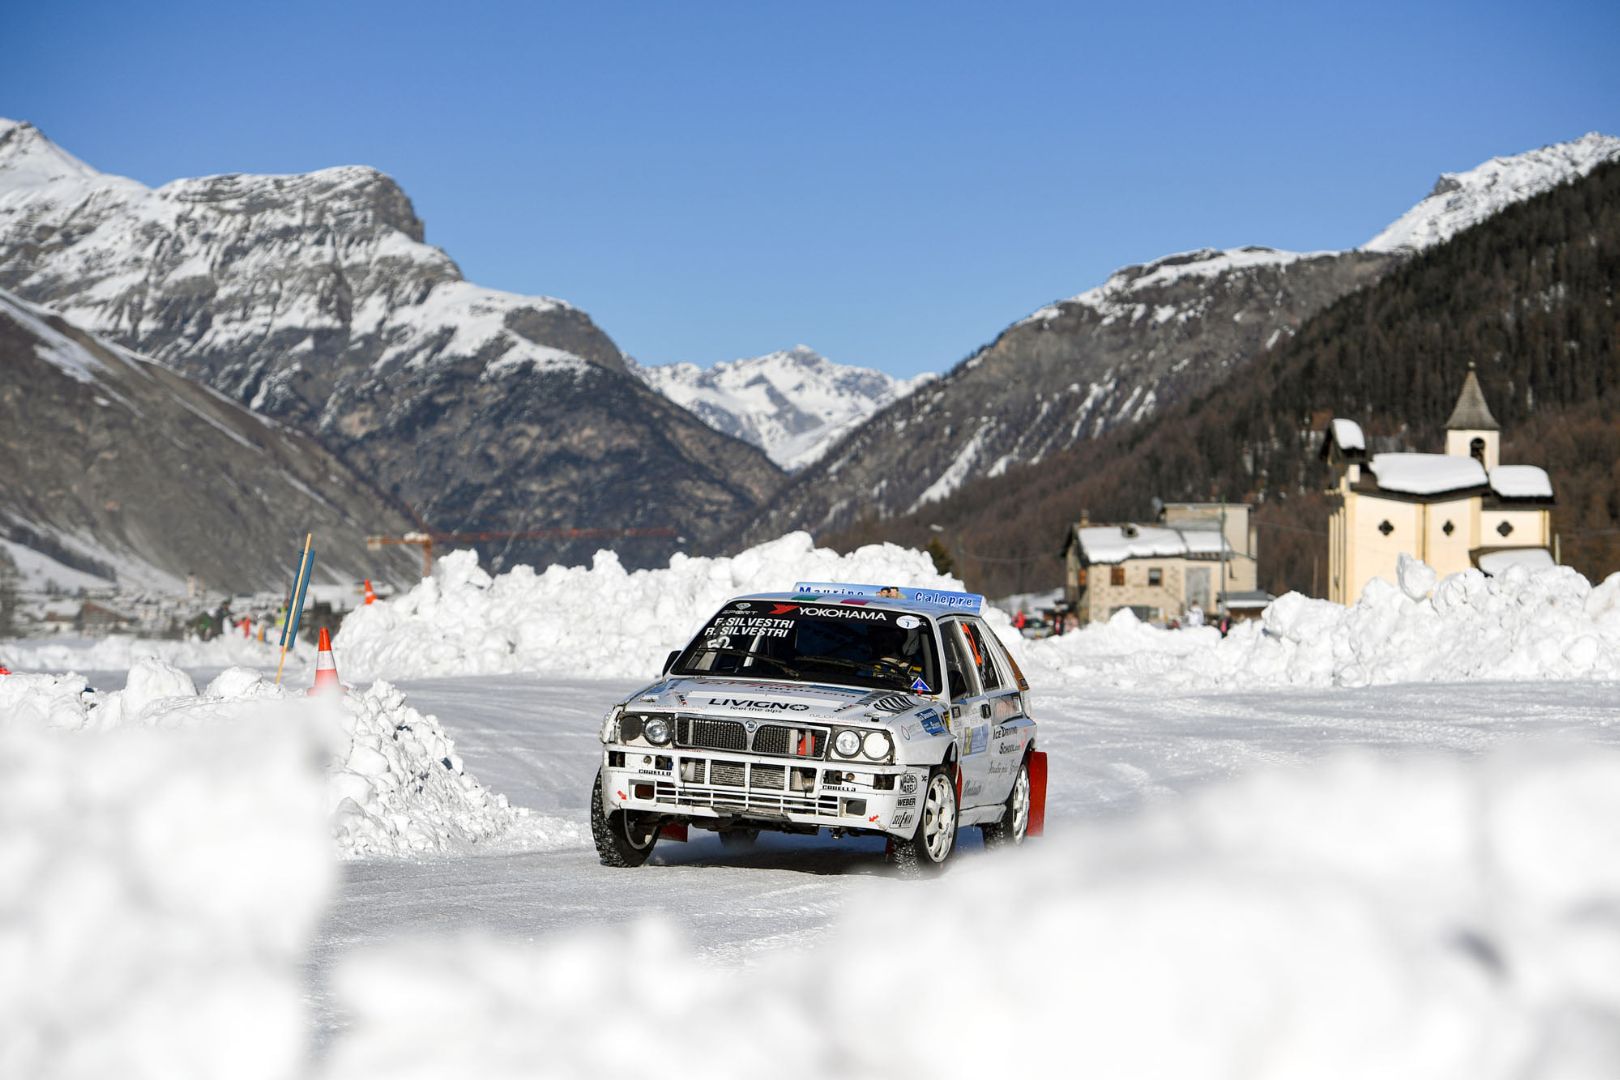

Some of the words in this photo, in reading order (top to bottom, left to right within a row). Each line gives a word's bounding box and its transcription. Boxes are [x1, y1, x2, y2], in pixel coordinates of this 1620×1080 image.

[915, 591, 973, 607] Calepre
[799, 606, 887, 621] YOKOHAMA
[720, 626, 789, 638] SILVESTRI
[708, 698, 810, 712] LIVIGNO
[897, 797, 916, 807] WEBER
